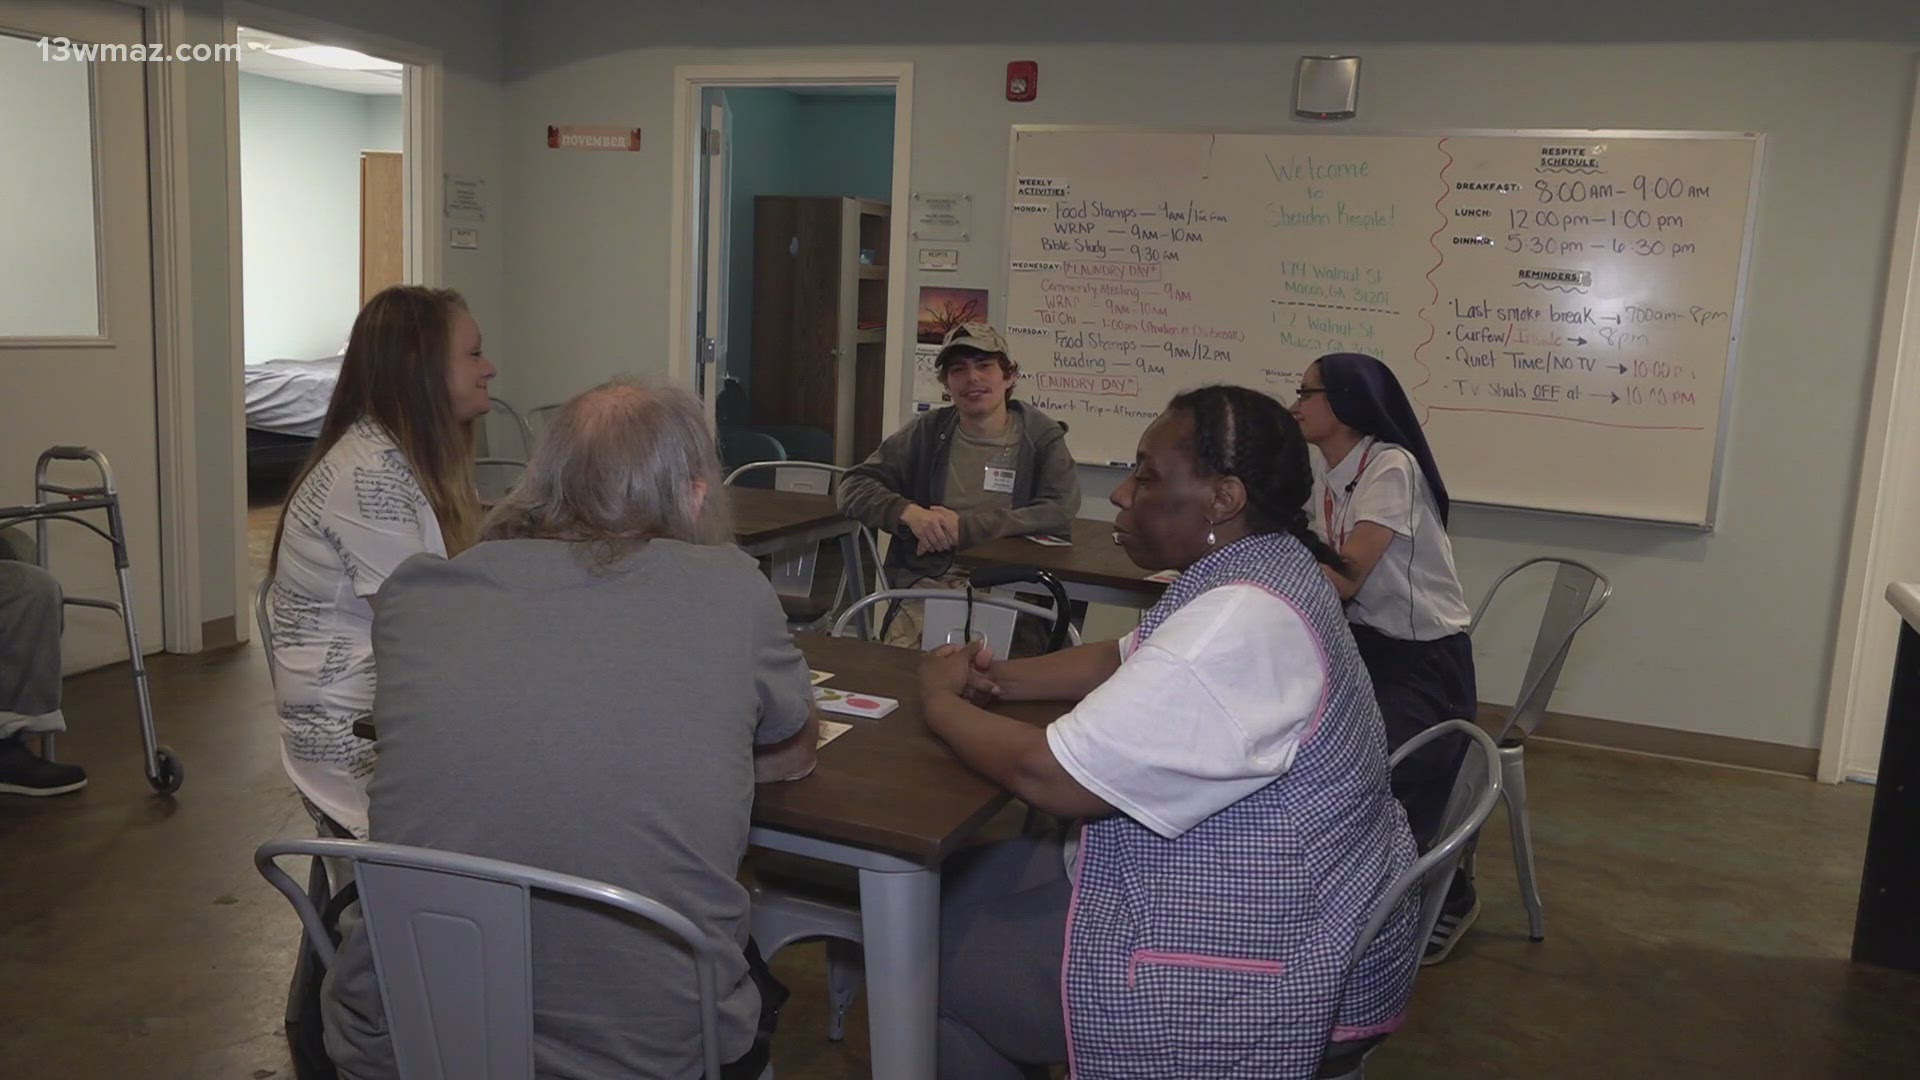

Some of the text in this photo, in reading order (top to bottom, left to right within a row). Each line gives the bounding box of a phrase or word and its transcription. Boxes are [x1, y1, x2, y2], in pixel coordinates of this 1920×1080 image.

[1540, 157, 1599, 168] SCHEDULE:
[1541, 147, 1586, 156] RESPITE
[1265, 153, 1369, 182] Welcome
[1018, 178, 1052, 187] WEEKLY
[1307, 186, 1323, 200] to
[1056, 200, 1087, 219] Food
[1091, 201, 1137, 224] Stamps
[1455, 208, 1492, 218] LUNCH:
[1054, 222, 1095, 235] WRAP
[1041, 237, 1071, 250] Bible
[1075, 237, 1106, 258] Study
[1281, 260, 1382, 286] 174 Walnut St
[1040, 278, 1097, 300] Community
[1099, 281, 1140, 303] Meeting
[1044, 294, 1080, 309] WRAP
[1034, 309, 1057, 325] Tai
[1059, 310, 1077, 326] Chi
[1455, 298, 1492, 319] Last
[1497, 303, 1541, 322] smoke
[1549, 304, 1597, 325] break
[1307, 314, 1350, 337] Walnut
[1055, 330, 1083, 349] Food
[1088, 332, 1137, 356] Stamps
[1053, 350, 1106, 374] Reading
[1455, 346, 1497, 368] Quiet
[1578, 357, 1597, 372] TV
[1452, 379, 1481, 396] TV
[1488, 382, 1527, 399] Shuts
[1532, 384, 1561, 401] OFF
[1566, 385, 1583, 400] at
